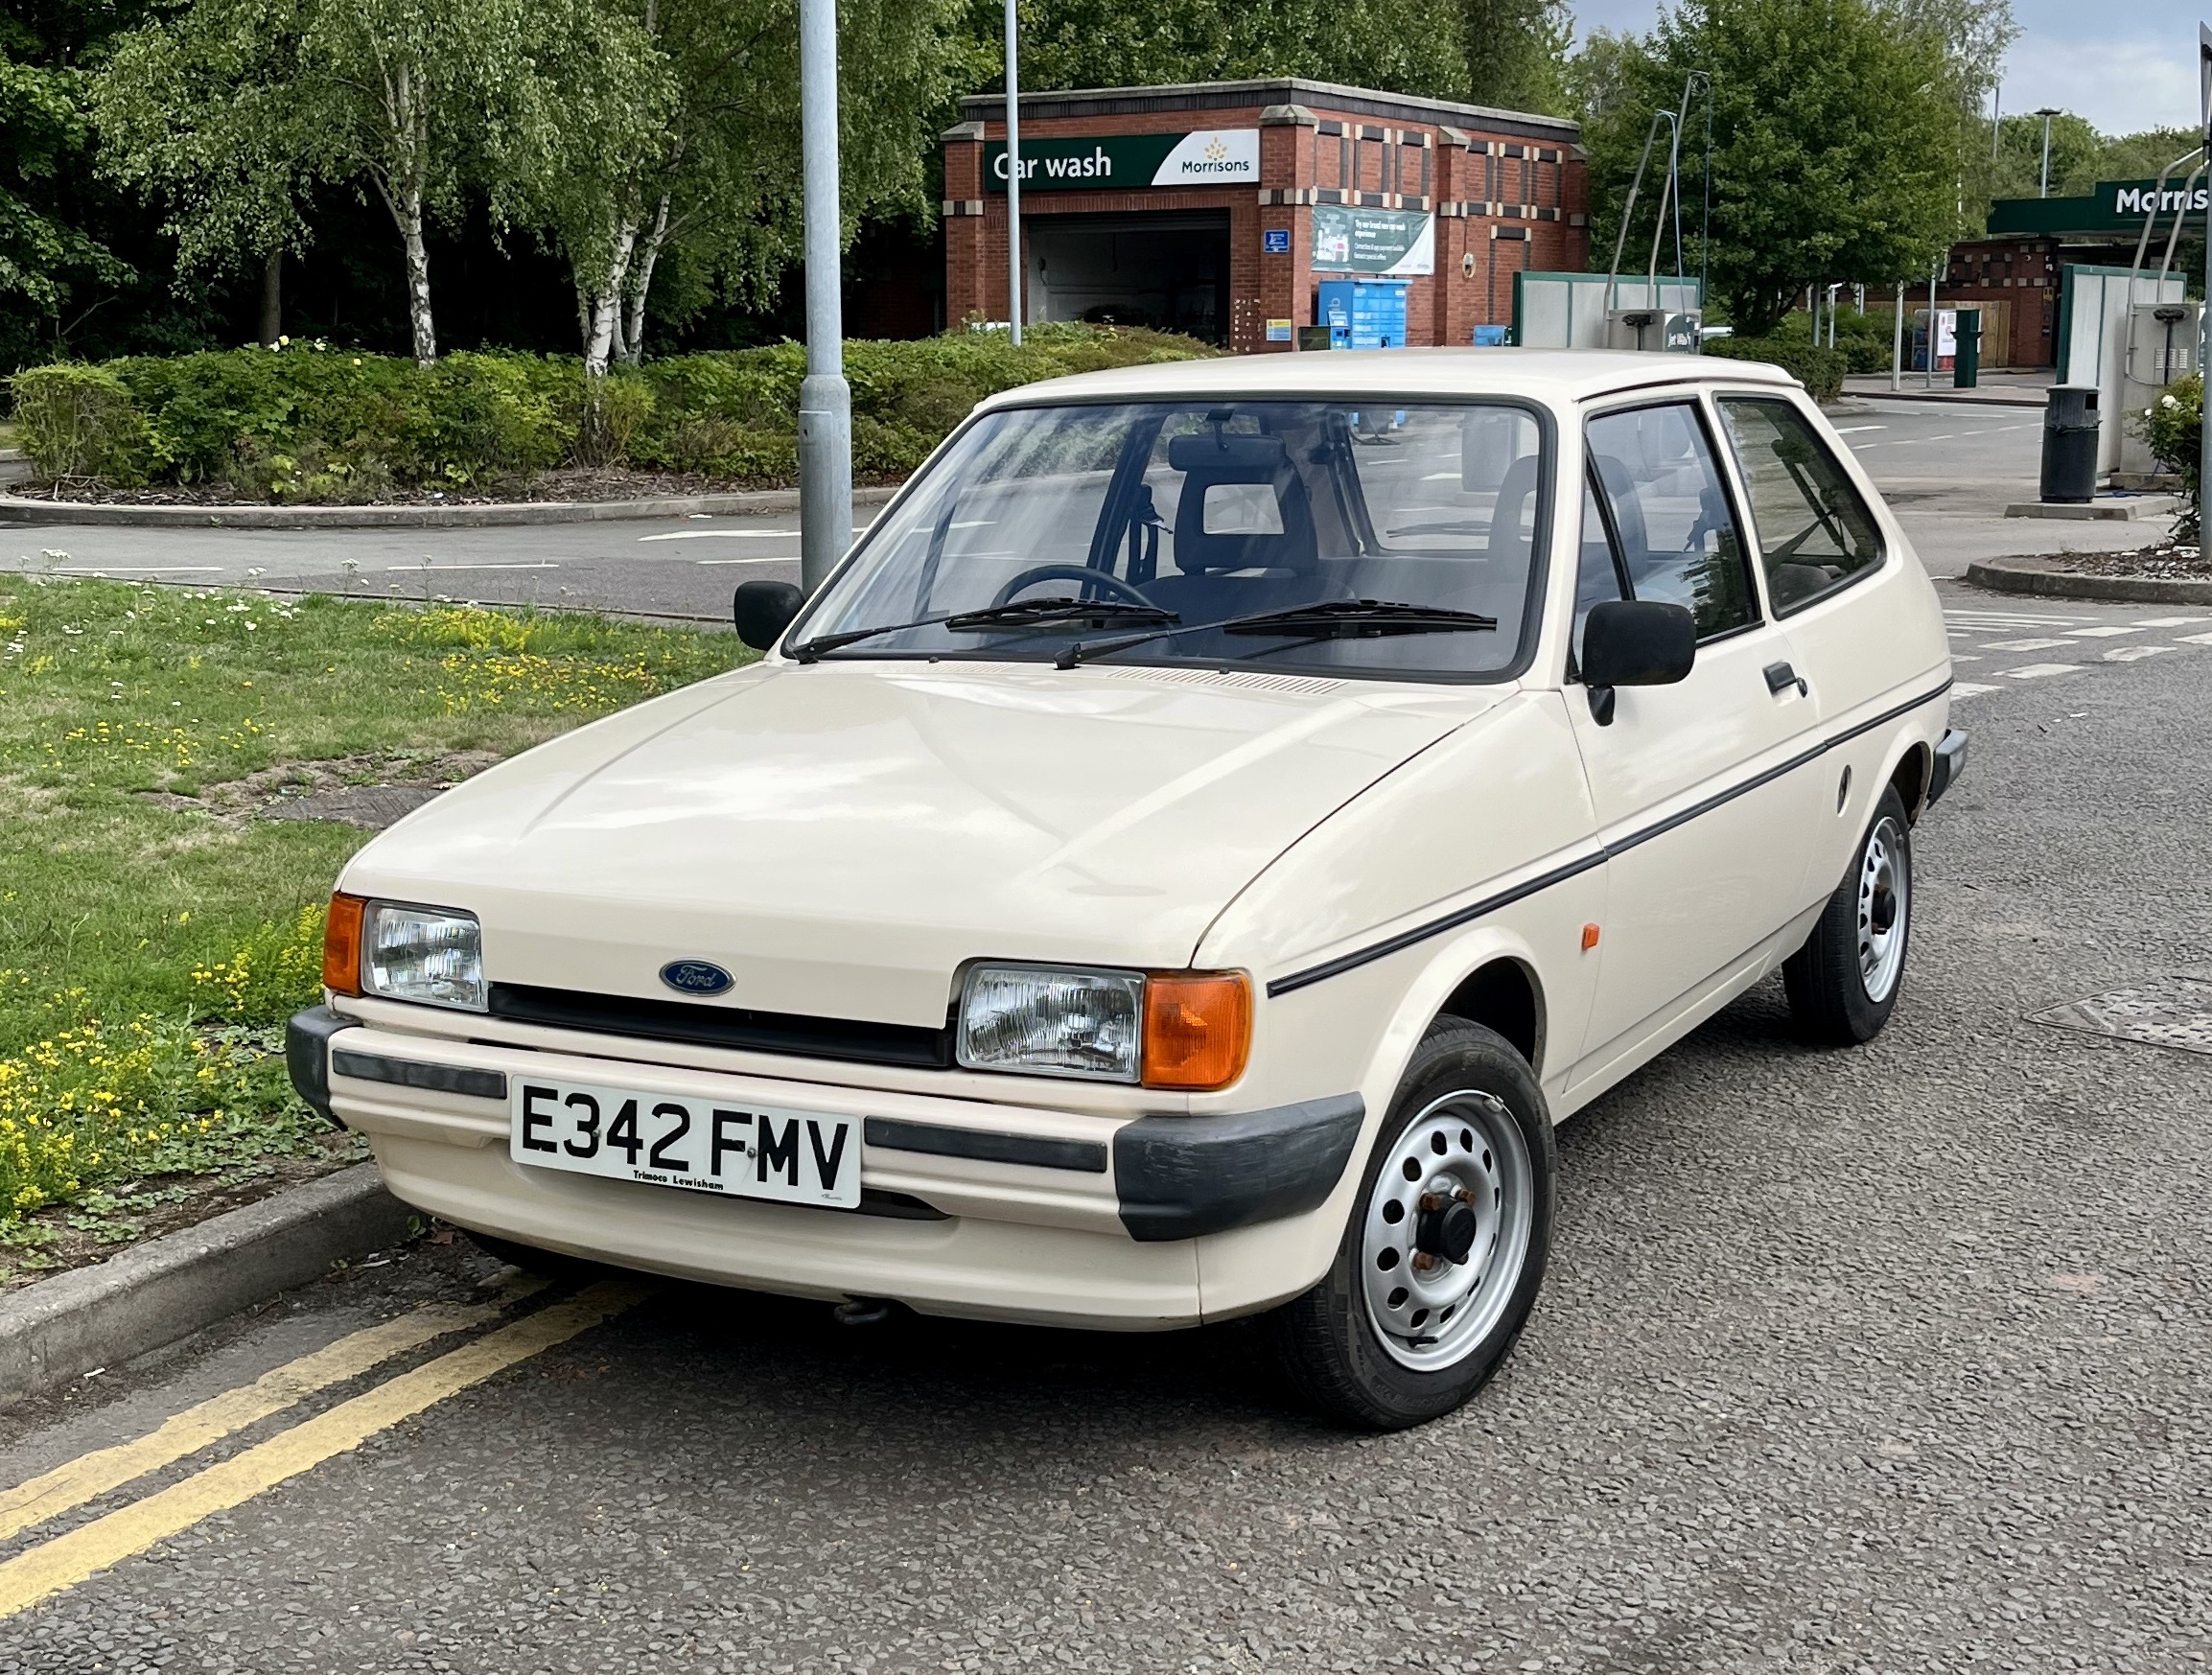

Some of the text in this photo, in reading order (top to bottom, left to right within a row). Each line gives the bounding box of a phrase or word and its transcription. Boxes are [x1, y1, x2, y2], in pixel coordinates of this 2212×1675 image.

[993, 146, 1112, 180] Car wash
[1180, 159, 1250, 174] Morrisons
[676, 965, 717, 988] Ford
[523, 1084, 850, 1191] E342 FMV
[633, 1169, 724, 1191] Trimoco Lewisham
